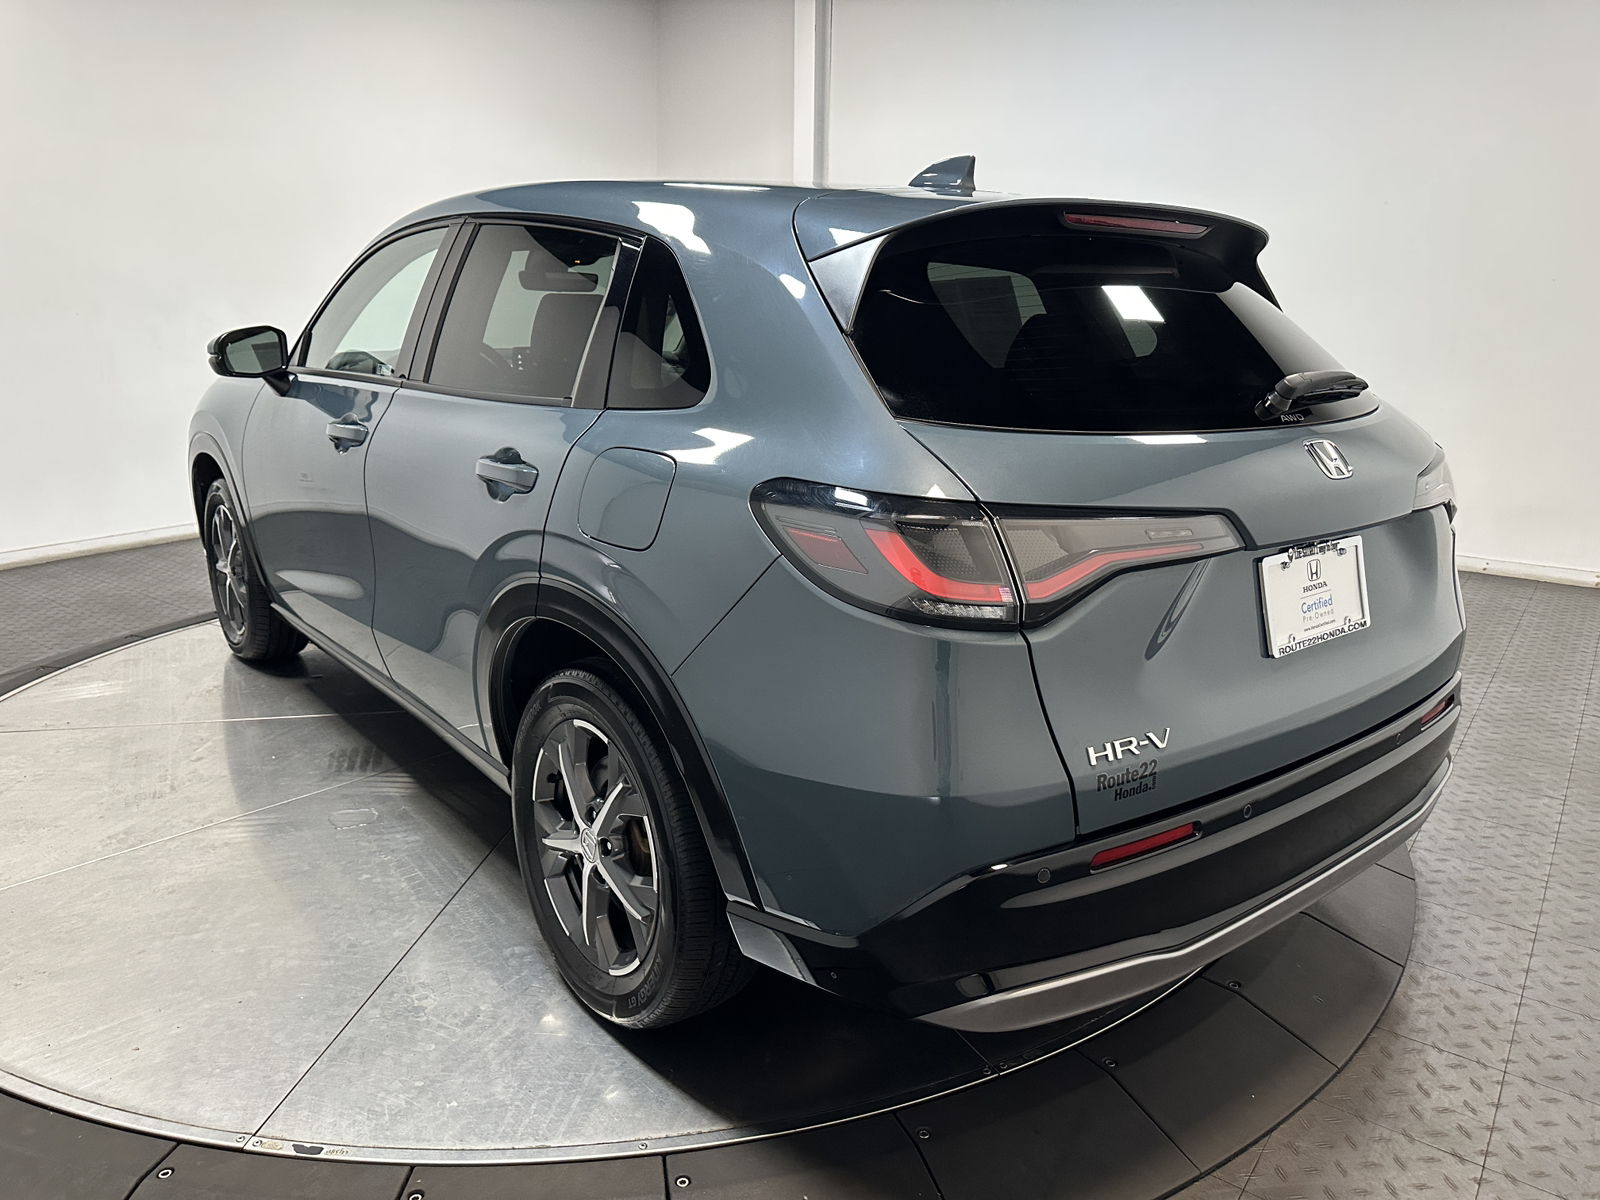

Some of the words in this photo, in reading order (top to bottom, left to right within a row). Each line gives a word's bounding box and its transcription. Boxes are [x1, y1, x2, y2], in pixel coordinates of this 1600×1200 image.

[1280, 413, 1305, 423] AWD
[1302, 581, 1328, 593] HONDA
[1301, 594, 1333, 614] Certified
[1302, 608, 1334, 623] Pre-Owned
[1278, 620, 1367, 656] ROUTE22HONDA.COM
[1086, 727, 1170, 766] HR-V
[1096, 758, 1158, 792] Route22
[628, 996, 637, 1009] GT
